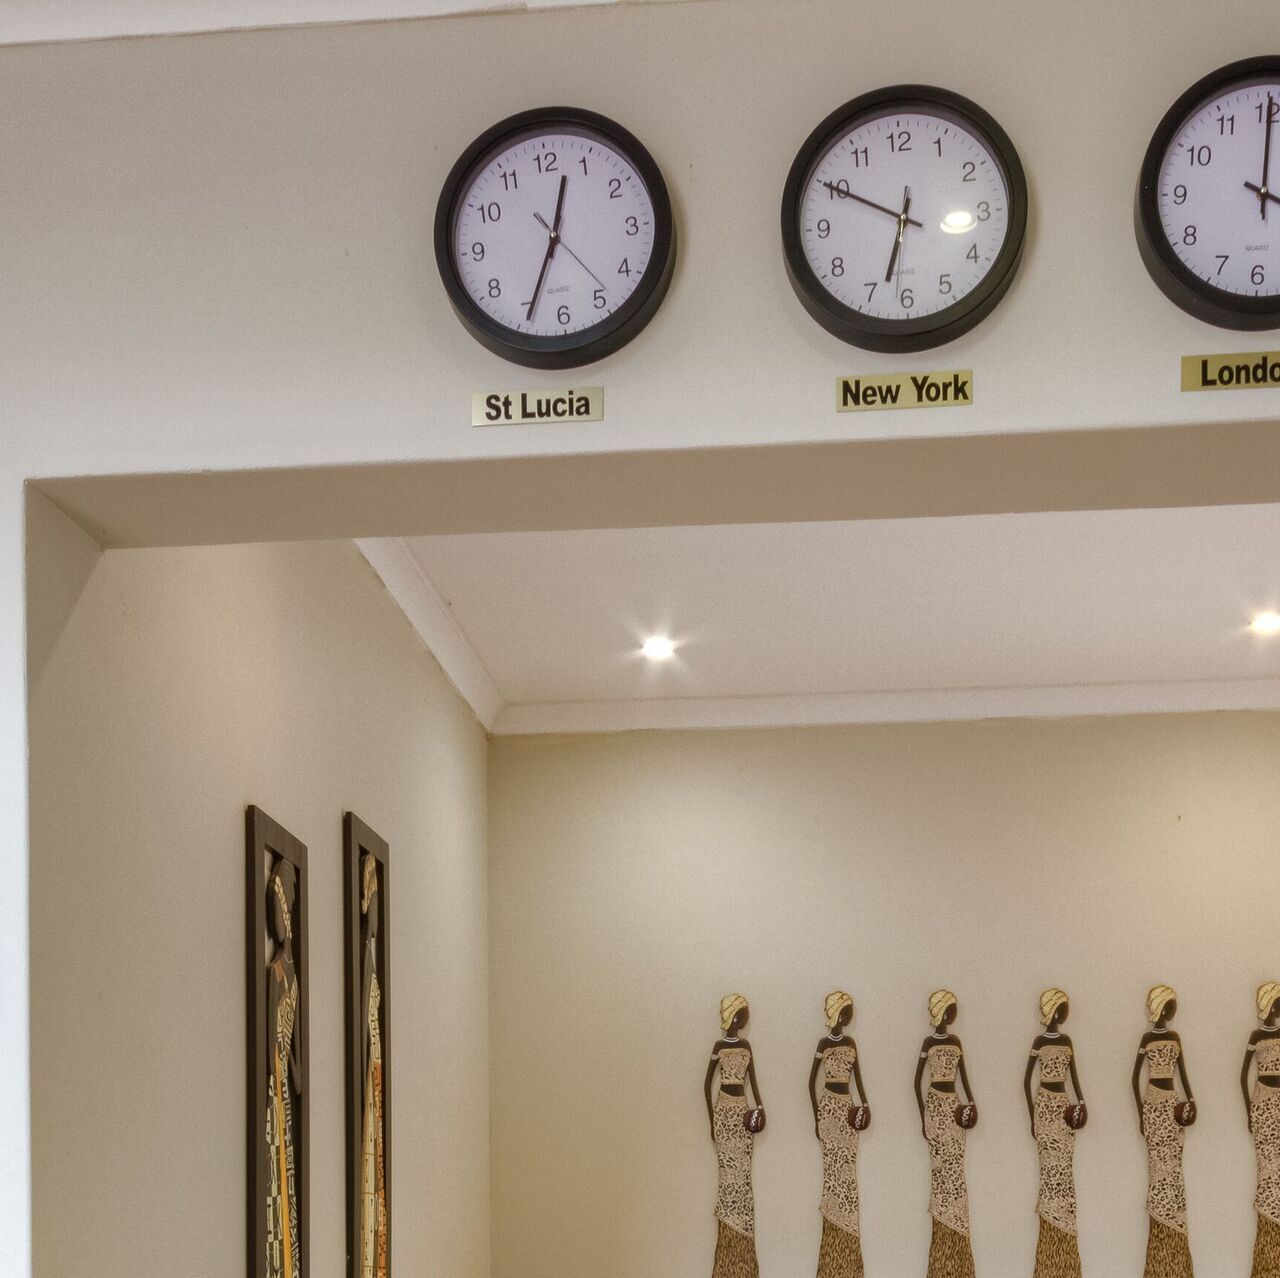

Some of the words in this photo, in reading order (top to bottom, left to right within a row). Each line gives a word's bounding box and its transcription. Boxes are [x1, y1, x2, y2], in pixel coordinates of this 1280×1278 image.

[1255, 103, 1280, 124] 12
[1217, 115, 1235, 135] 11
[887, 132, 912, 152] 12
[933, 138, 942, 157] 1
[534, 152, 558, 173] 12
[851, 147, 869, 167] 11
[1187, 146, 1212, 166] 10
[579, 157, 588, 176] 1
[963, 162, 976, 183] 2
[500, 170, 518, 190] 11
[609, 179, 623, 199] 2
[827, 179, 850, 200] 10
[1173, 185, 1187, 205] 9
[477, 202, 501, 223] 10
[977, 201, 990, 221] 3
[625, 216, 639, 236] 3
[817, 219, 830, 239] 9
[1183, 225, 1197, 246] 8
[471, 242, 485, 262] 9
[966, 244, 979, 264] 4
[618, 257, 632, 277] 4
[831, 257, 845, 277] 8
[1216, 255, 1229, 275] 7
[939, 274, 952, 294] 5
[1251, 265, 1264, 286] 6
[488, 278, 501, 298] 8
[864, 283, 878, 303] 7
[593, 289, 606, 309] 5
[901, 289, 914, 309] 6
[557, 306, 571, 325] 6
[841, 379, 902, 407] New
[911, 373, 970, 403] York
[485, 394, 513, 421] St
[520, 390, 591, 419] Lucia
